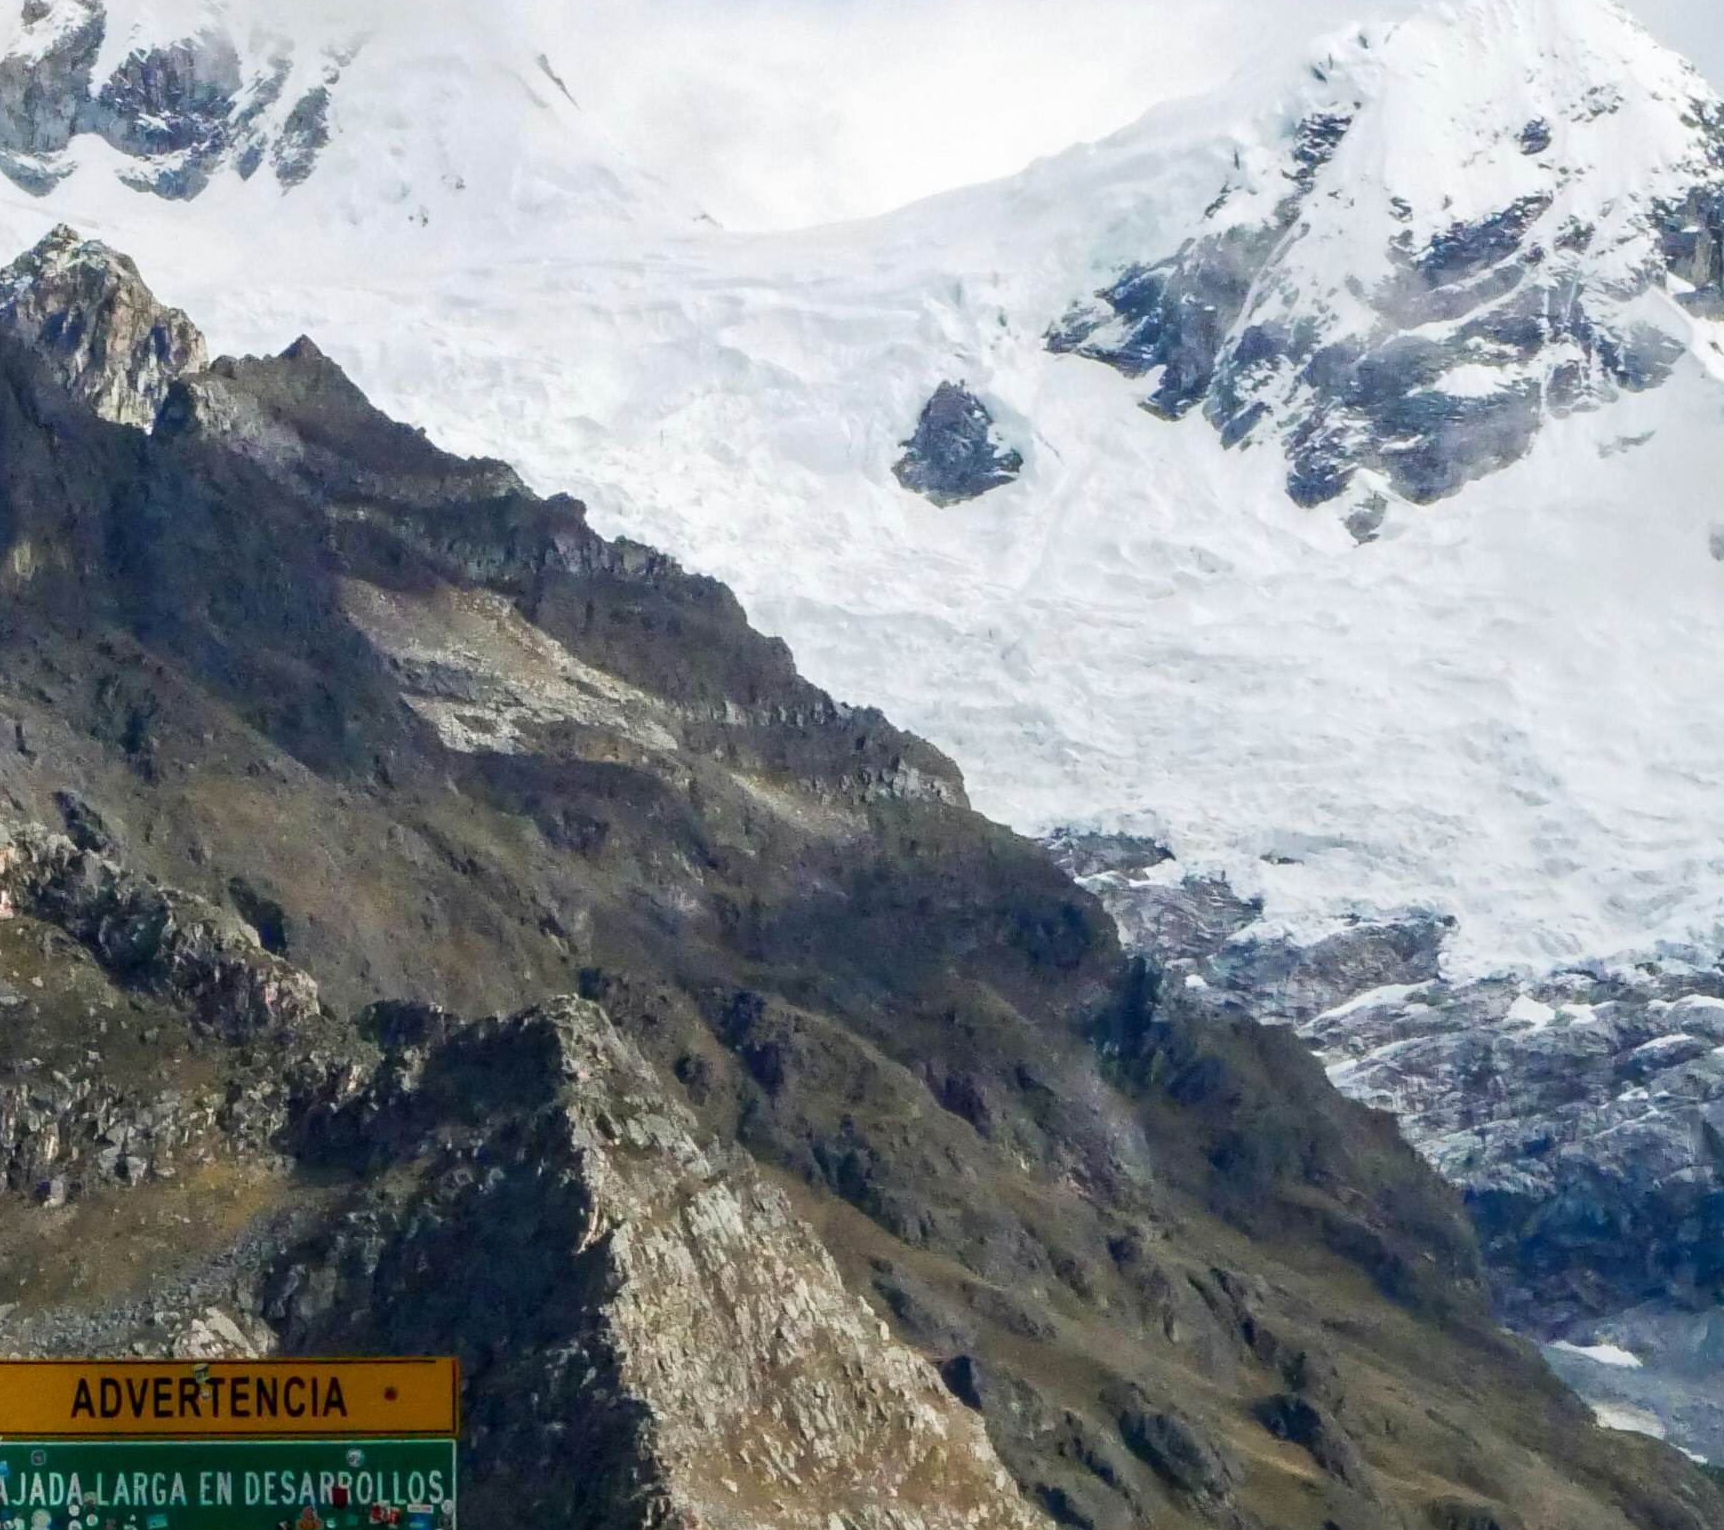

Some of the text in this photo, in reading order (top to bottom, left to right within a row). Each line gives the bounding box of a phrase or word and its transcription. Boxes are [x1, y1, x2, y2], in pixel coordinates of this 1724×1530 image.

[71, 1377, 348, 1418] ADVERTENCIA
[96, 1471, 187, 1506] LARGA
[199, 1471, 233, 1506] EN
[245, 1470, 445, 1506] DESARROLLOS
